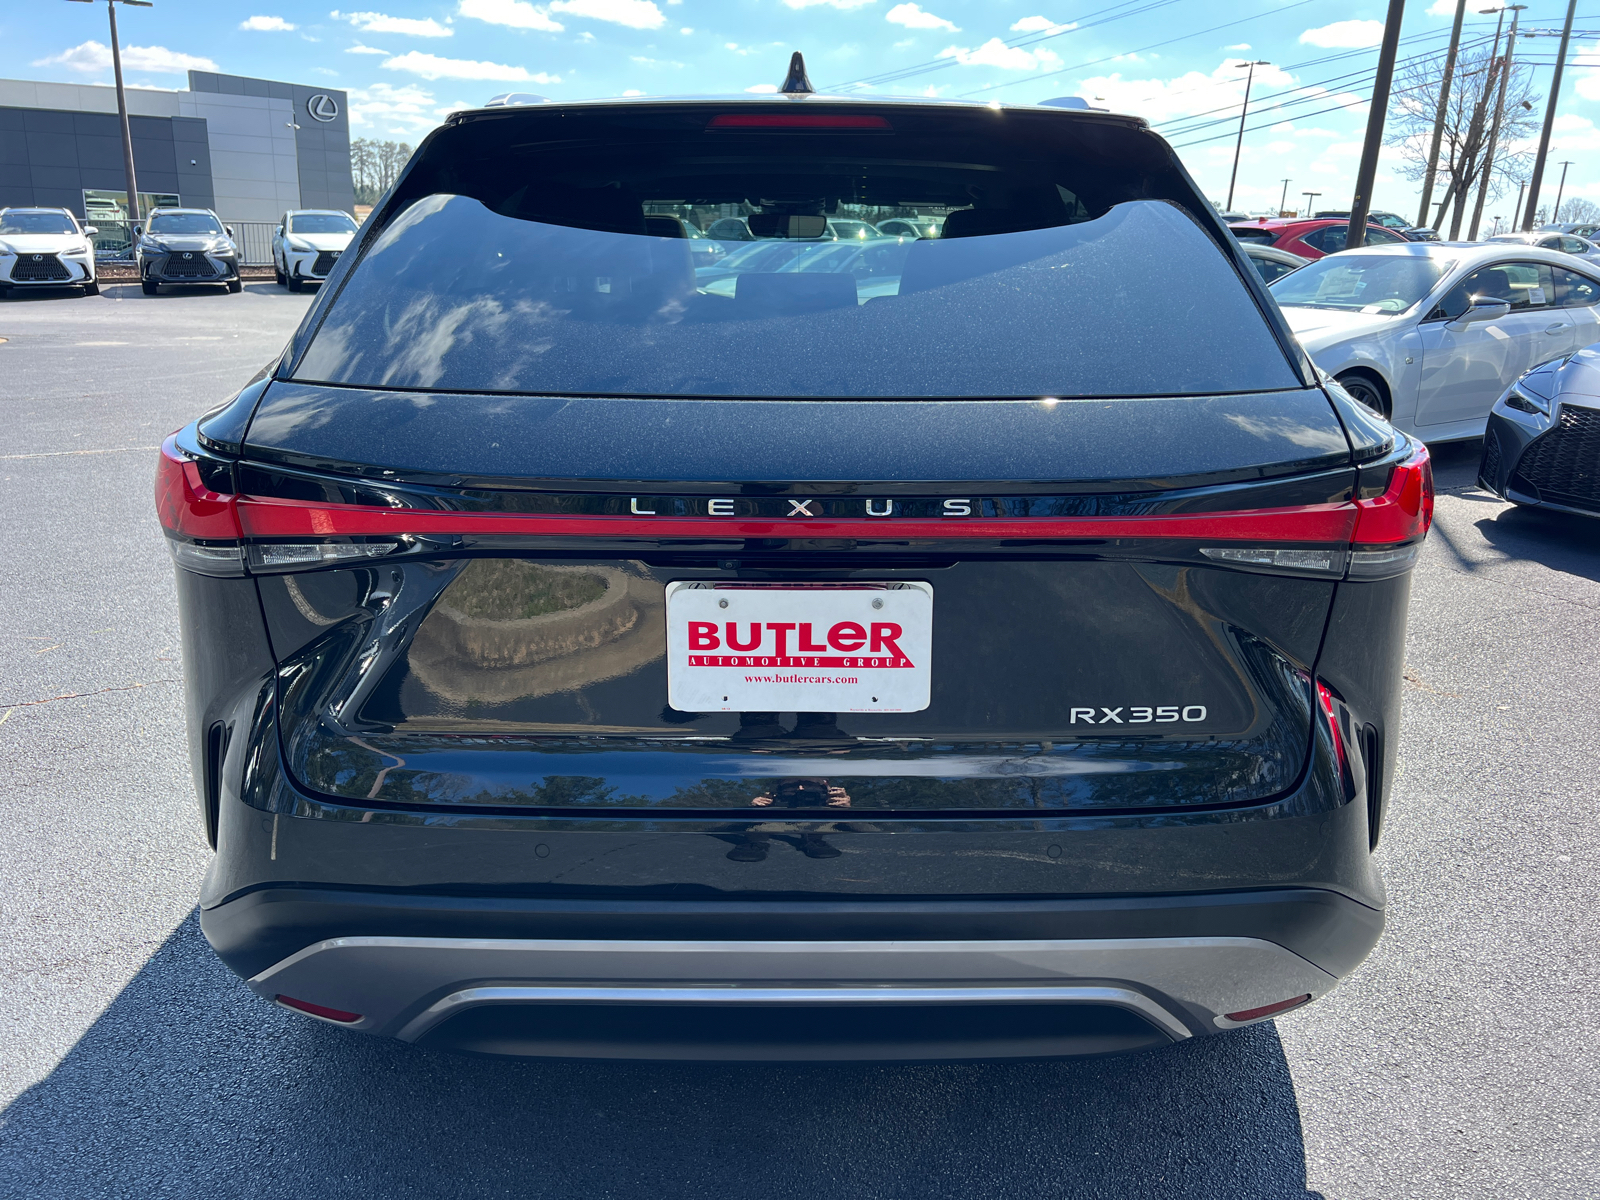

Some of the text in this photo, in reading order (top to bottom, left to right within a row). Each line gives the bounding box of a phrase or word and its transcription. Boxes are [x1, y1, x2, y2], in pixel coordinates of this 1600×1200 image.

[630, 497, 972, 517] LEXUS
[689, 655, 908, 668] AUTOMOTIVE GROUP
[744, 673, 859, 685] www.butlercars.com
[1069, 705, 1208, 724] RX350
